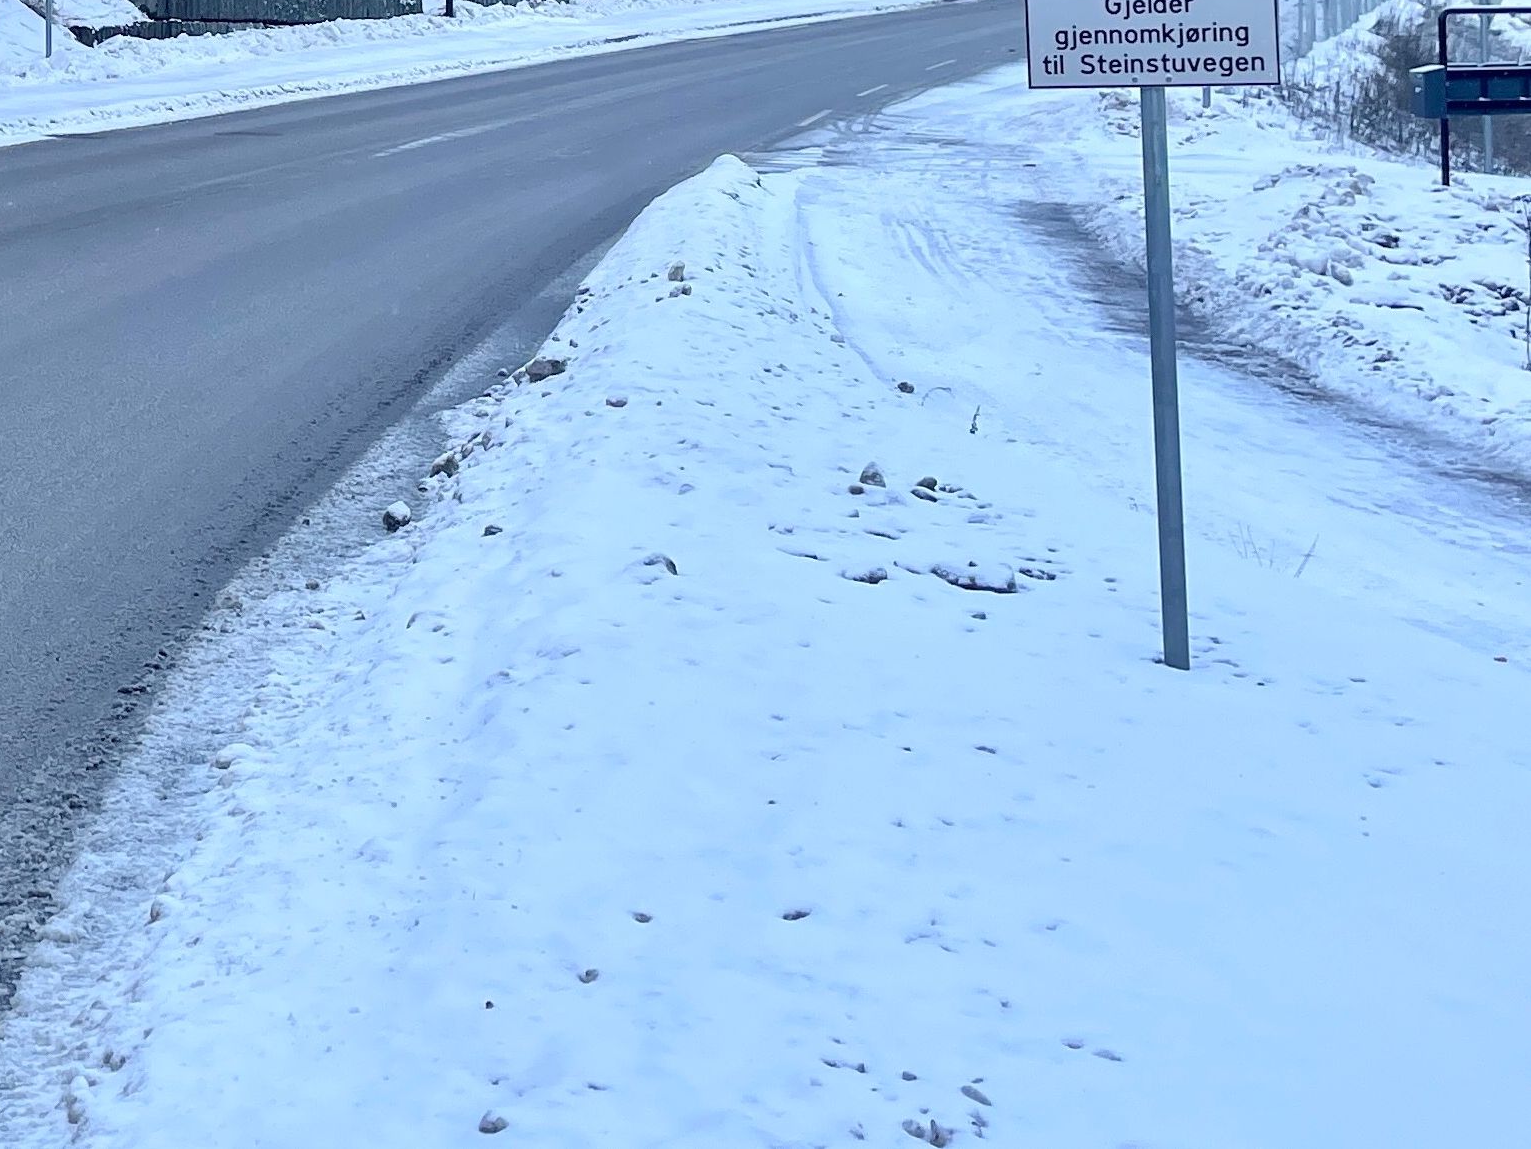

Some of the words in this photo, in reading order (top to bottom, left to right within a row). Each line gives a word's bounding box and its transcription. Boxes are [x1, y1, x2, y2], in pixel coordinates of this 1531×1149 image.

[1055, 22, 1249, 51] gjennomkjøring
[1042, 54, 1065, 75] til
[1080, 53, 1266, 77] Steinstuvegen
